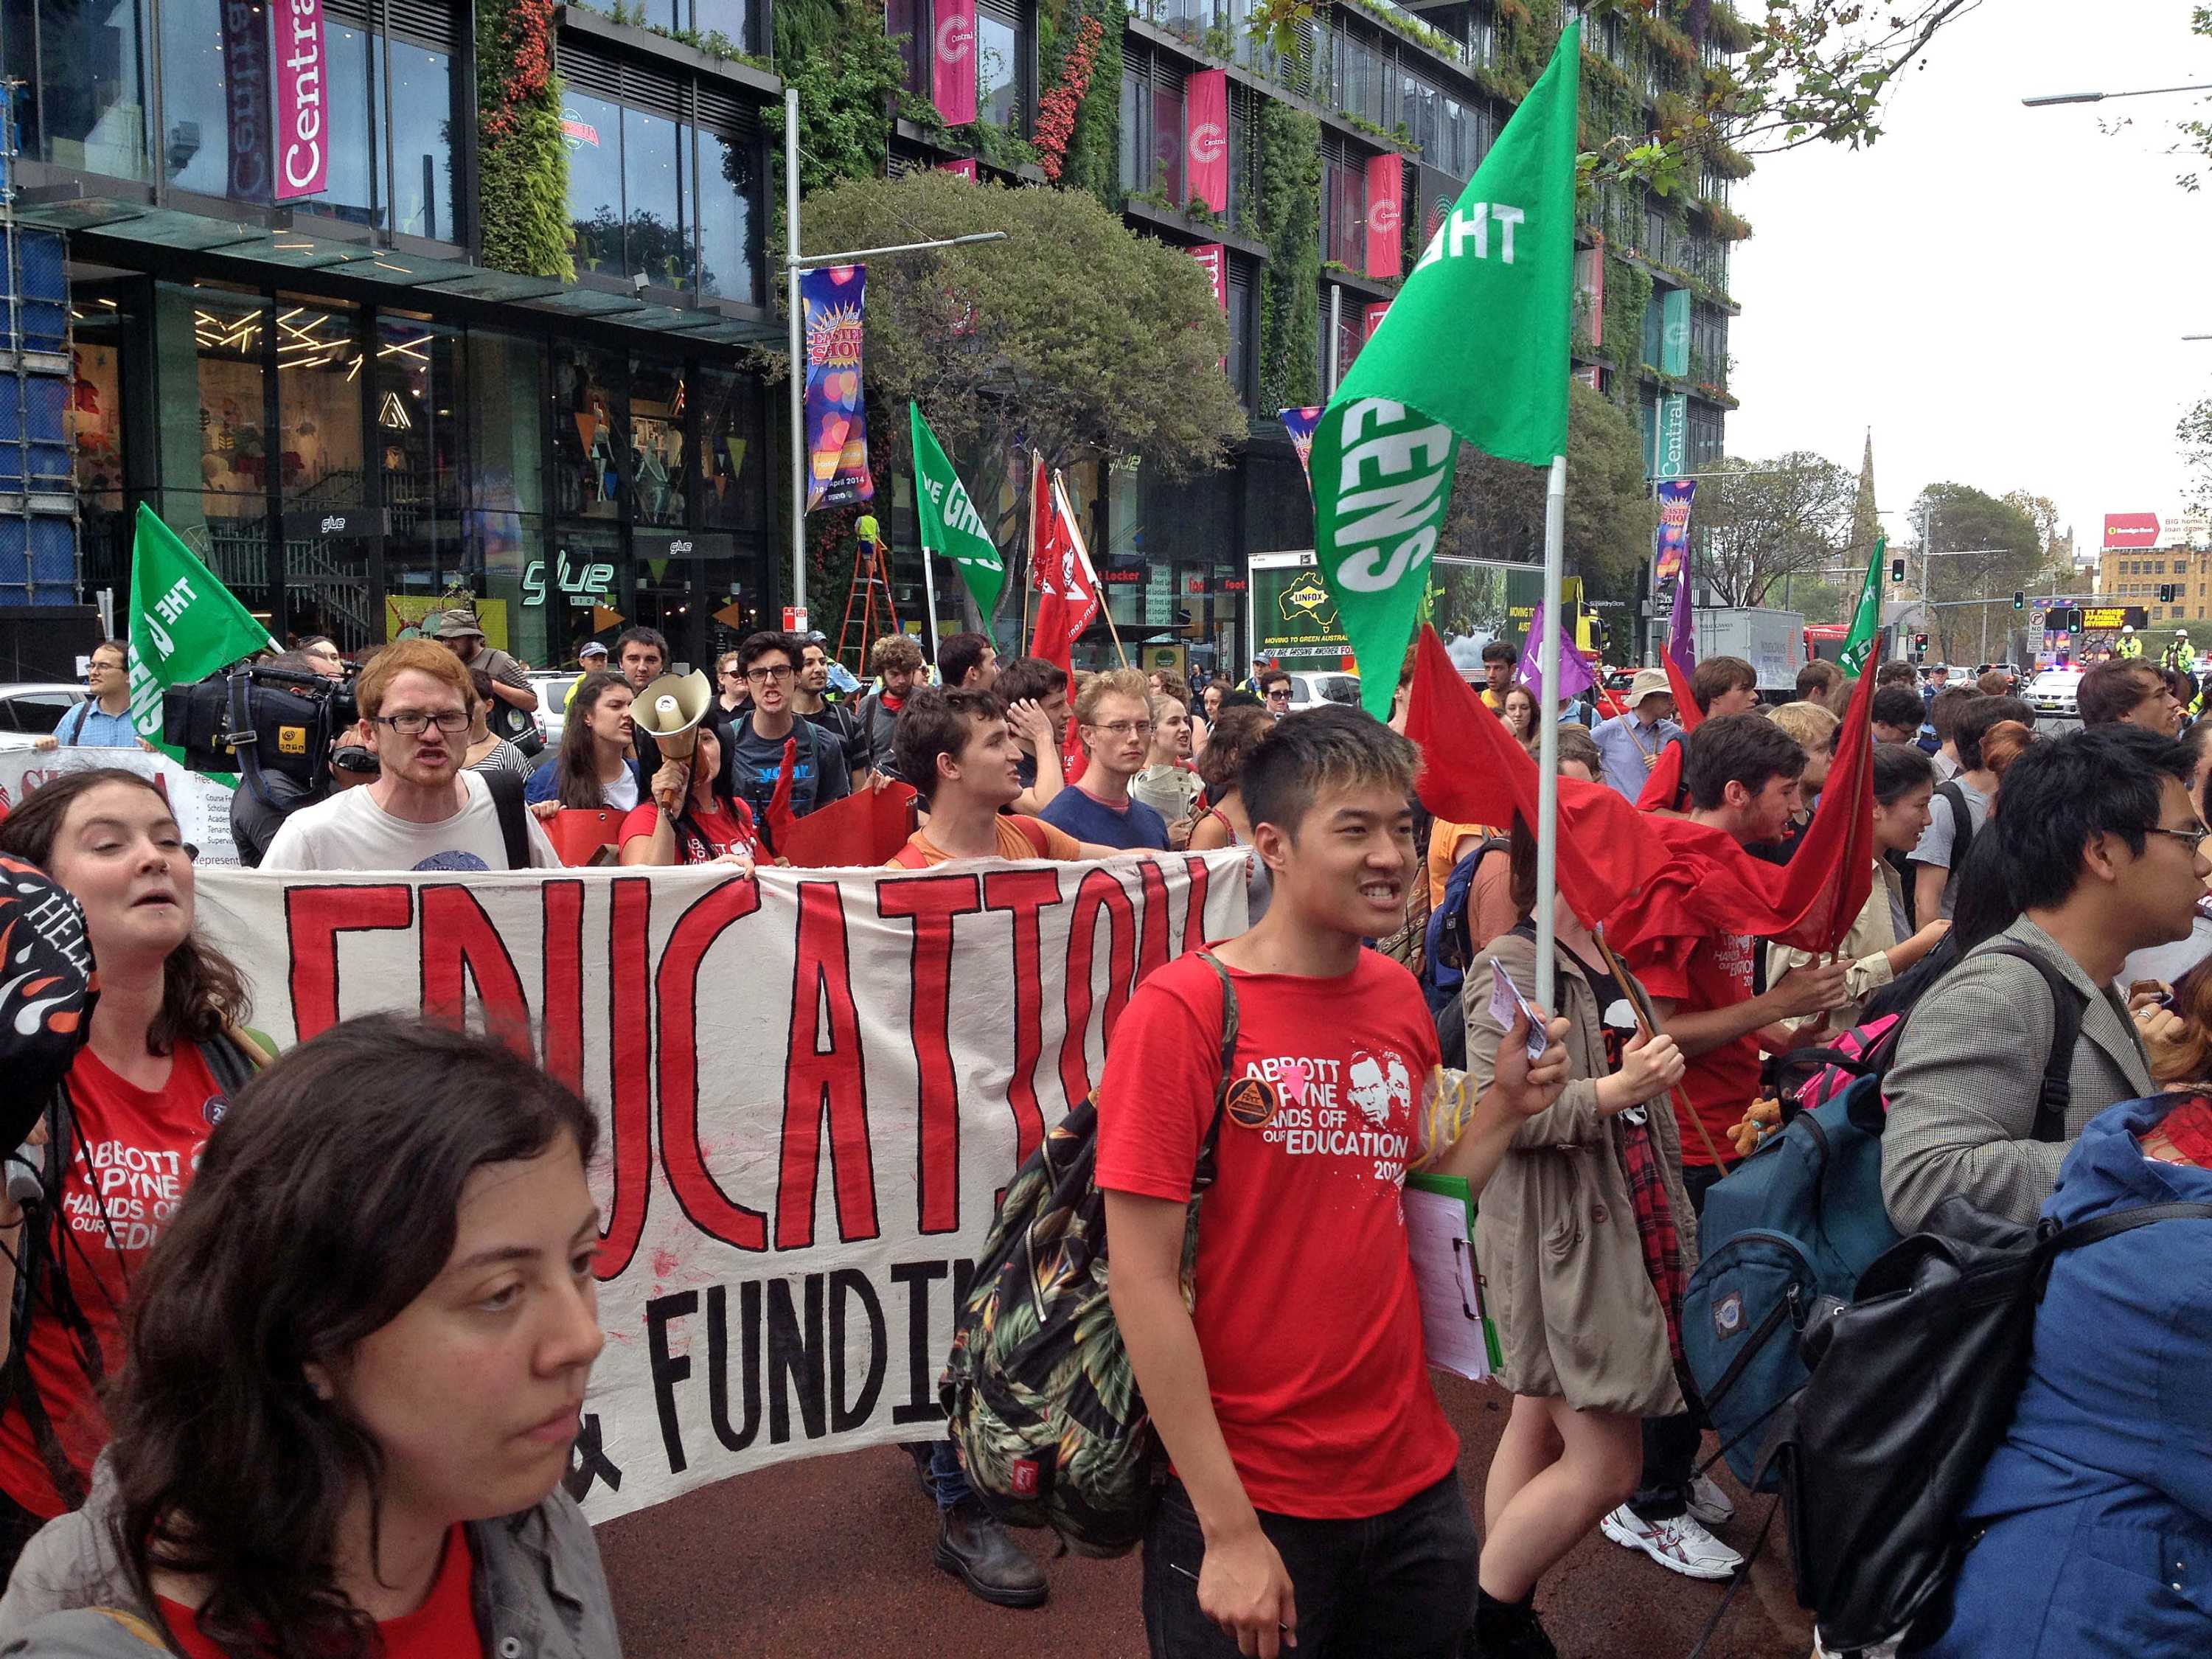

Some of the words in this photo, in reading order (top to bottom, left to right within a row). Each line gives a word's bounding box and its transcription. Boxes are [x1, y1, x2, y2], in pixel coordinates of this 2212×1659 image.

[951, 32, 973, 43] Central
[1204, 137, 1226, 146] Central
[1662, 396, 1683, 477] Central
[846, 476, 865, 484] 2014
[321, 515, 346, 534] glue
[670, 539, 692, 554] glue
[1295, 594, 1322, 602] LINFOX
[1509, 607, 1528, 618] MOVING
[1318, 1110, 1347, 1128] OFF
[1262, 1130, 1286, 1143] OUR
[1285, 1130, 1409, 1158] EDUCATION
[101, 1167, 183, 1200] PYNE
[71, 1217, 106, 1234] OUR
